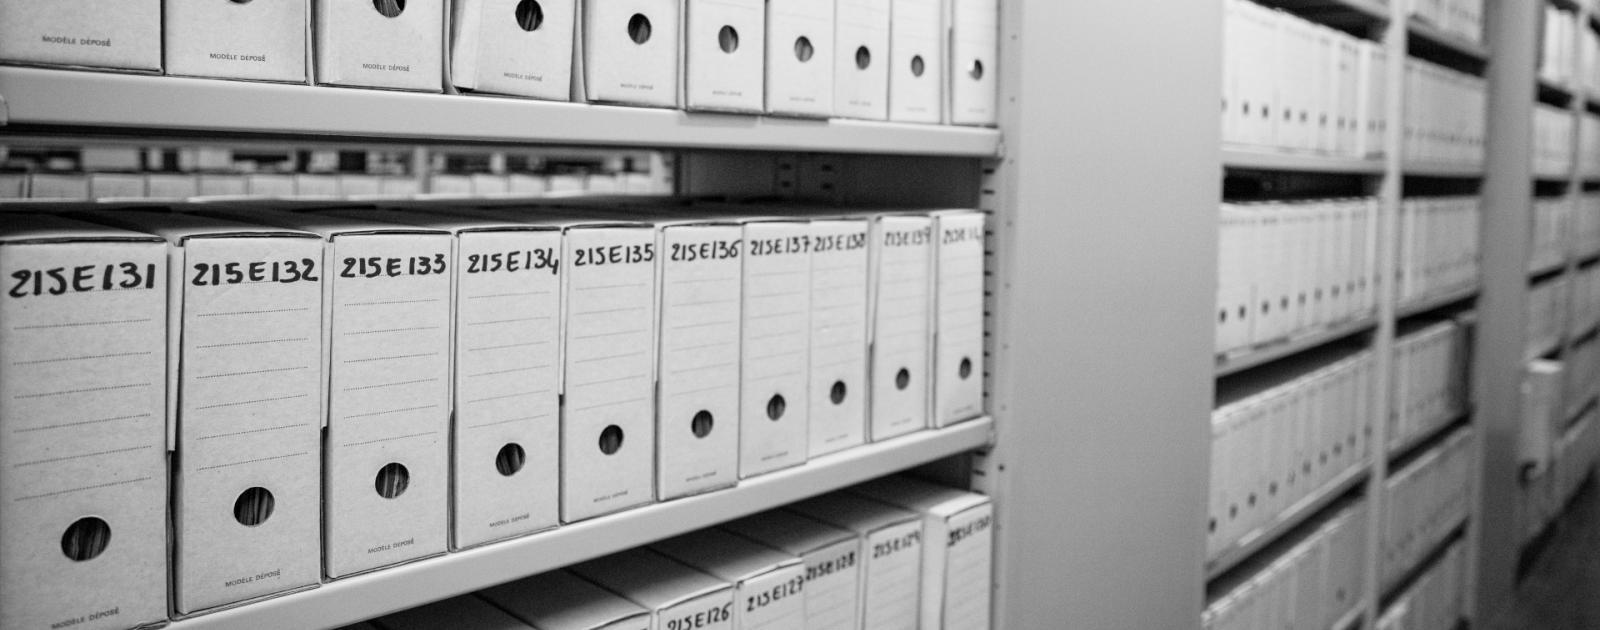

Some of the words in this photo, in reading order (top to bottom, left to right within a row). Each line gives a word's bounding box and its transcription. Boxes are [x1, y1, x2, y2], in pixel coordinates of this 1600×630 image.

[574, 243, 654, 266] 215E135
[671, 239, 743, 262] 215E136
[750, 235, 811, 256] 215E137
[192, 258, 319, 286] 215E132
[467, 248, 559, 275] 215E134
[9, 262, 155, 298] 215E131
